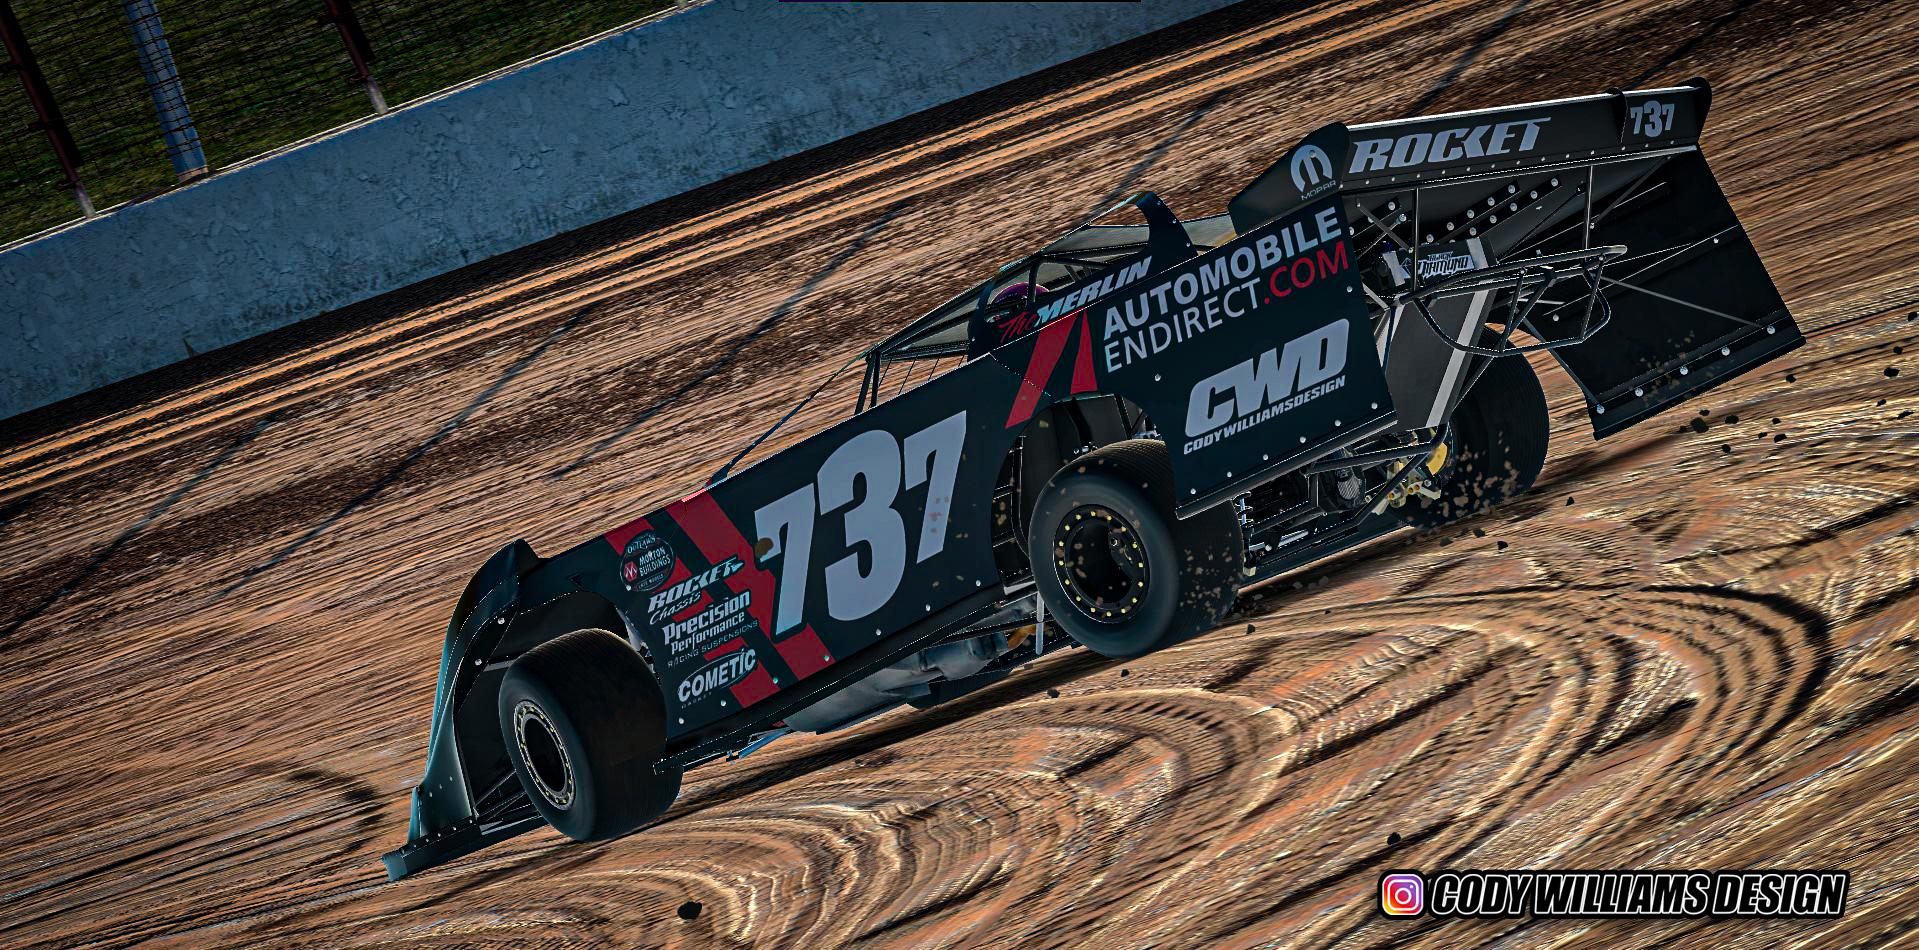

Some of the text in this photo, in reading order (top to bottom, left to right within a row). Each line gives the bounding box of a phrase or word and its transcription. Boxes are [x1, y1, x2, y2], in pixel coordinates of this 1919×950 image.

[1348, 116, 1552, 174] ROCKET
[1630, 100, 1675, 138] 737
[1300, 180, 1338, 201] MOPAR
[1034, 256, 1152, 327] MERLIN
[1103, 206, 1342, 341] AUTOMOBILE
[1185, 318, 1350, 437] CWD
[1183, 375, 1346, 455] CODYWILLIAMSDESIGN
[754, 410, 967, 636] 737
[639, 546, 666, 566] MORTON
[639, 554, 671, 577] BUILDINGS
[649, 591, 701, 625] Chassis
[661, 590, 751, 645] Precision
[670, 611, 745, 655] Performance
[677, 648, 756, 702] COMETIC
